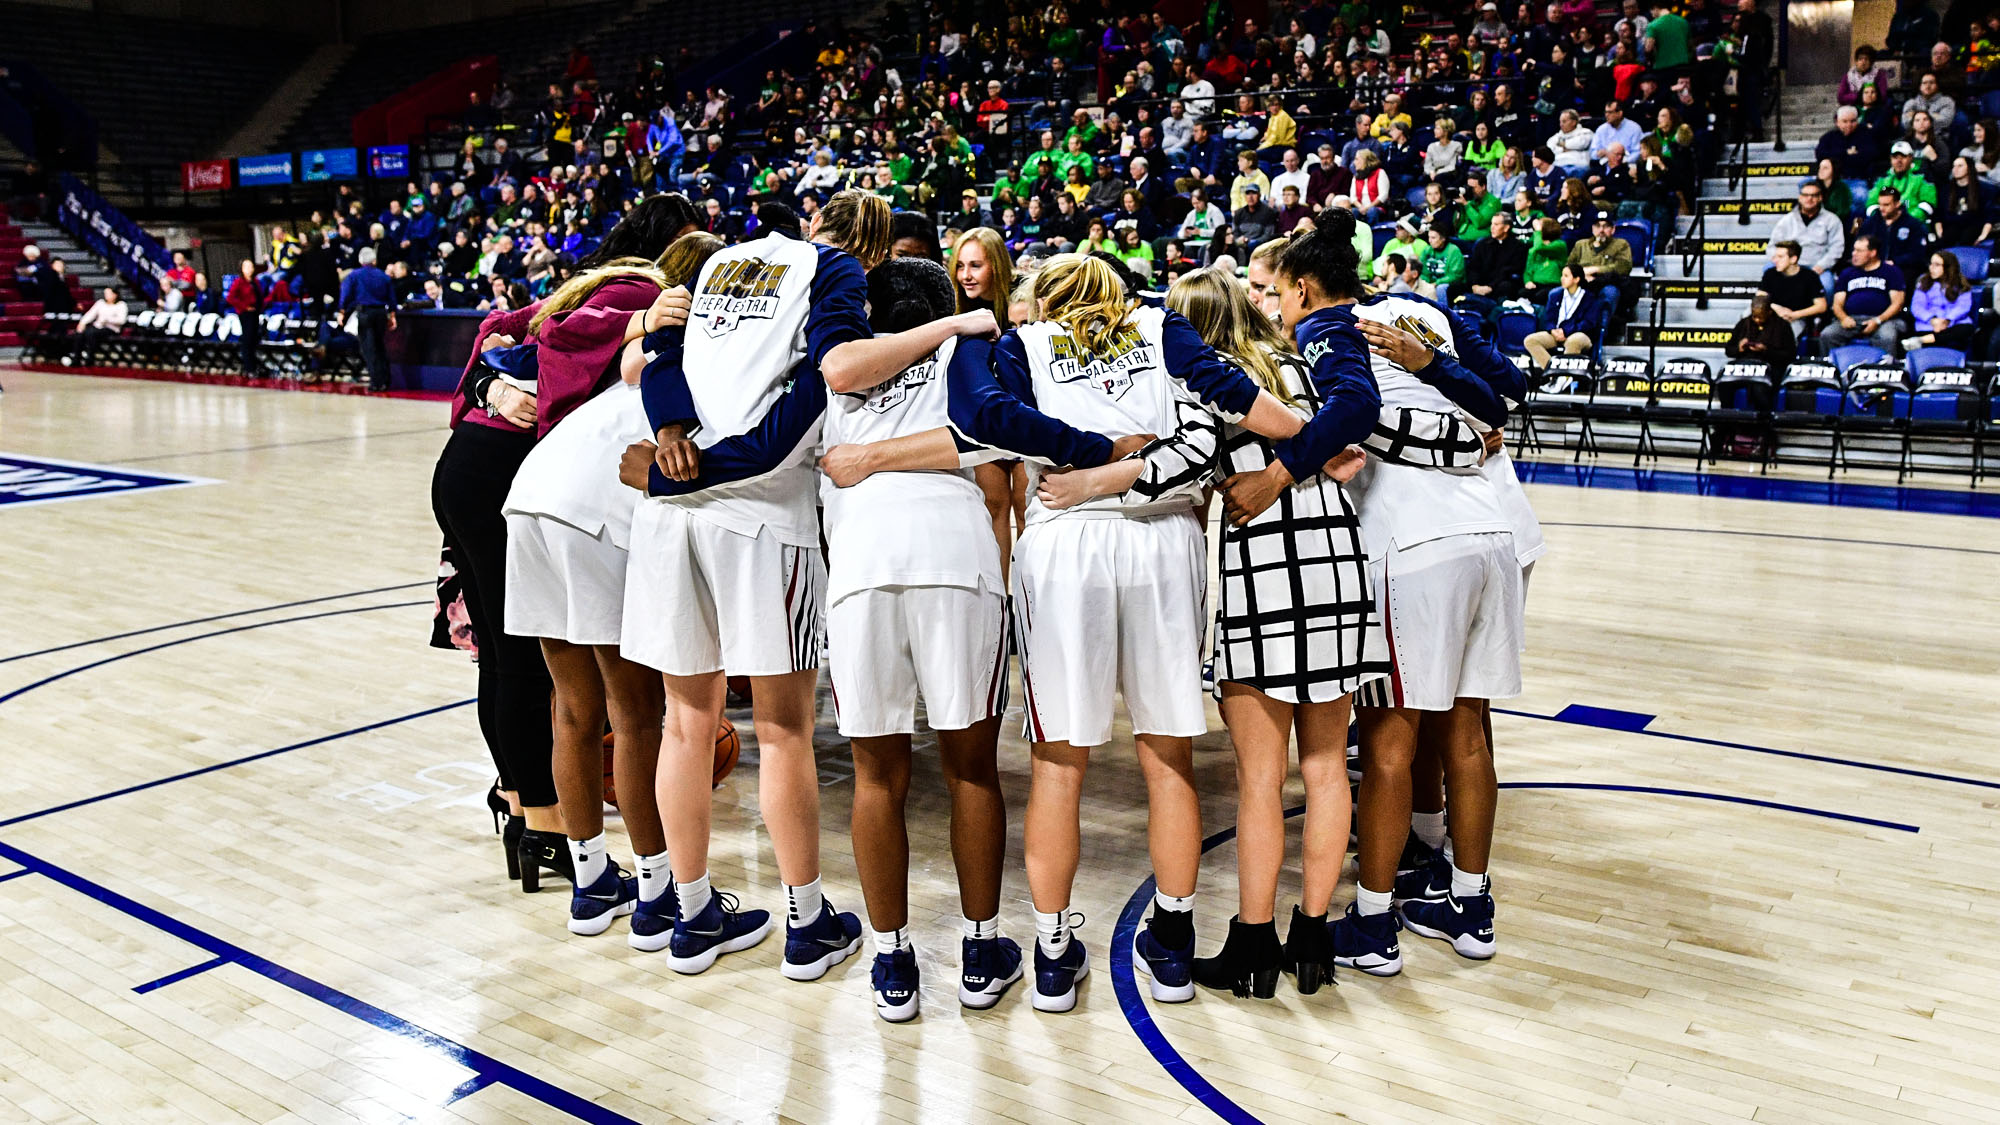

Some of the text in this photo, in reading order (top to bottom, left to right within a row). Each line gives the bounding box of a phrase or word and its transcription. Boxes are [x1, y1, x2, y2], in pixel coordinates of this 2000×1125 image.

[1768, 166, 1809, 175] OFFICER
[1748, 203, 1793, 212] ATHLETE
[1703, 242, 1768, 251] RMY SCHOLA
[1659, 331, 1685, 341] RMY
[1086, 350, 1150, 378] PALESTRA
[1550, 358, 1590, 370] PENN
[1606, 360, 1647, 373] PENN
[1662, 362, 1705, 374] PENN
[1723, 364, 1767, 376] PENN
[1789, 364, 1836, 379] PENN
[1856, 368, 1904, 383] PENN
[1922, 372, 1973, 385] PENN
[1661, 382, 1710, 394] OFFICER
